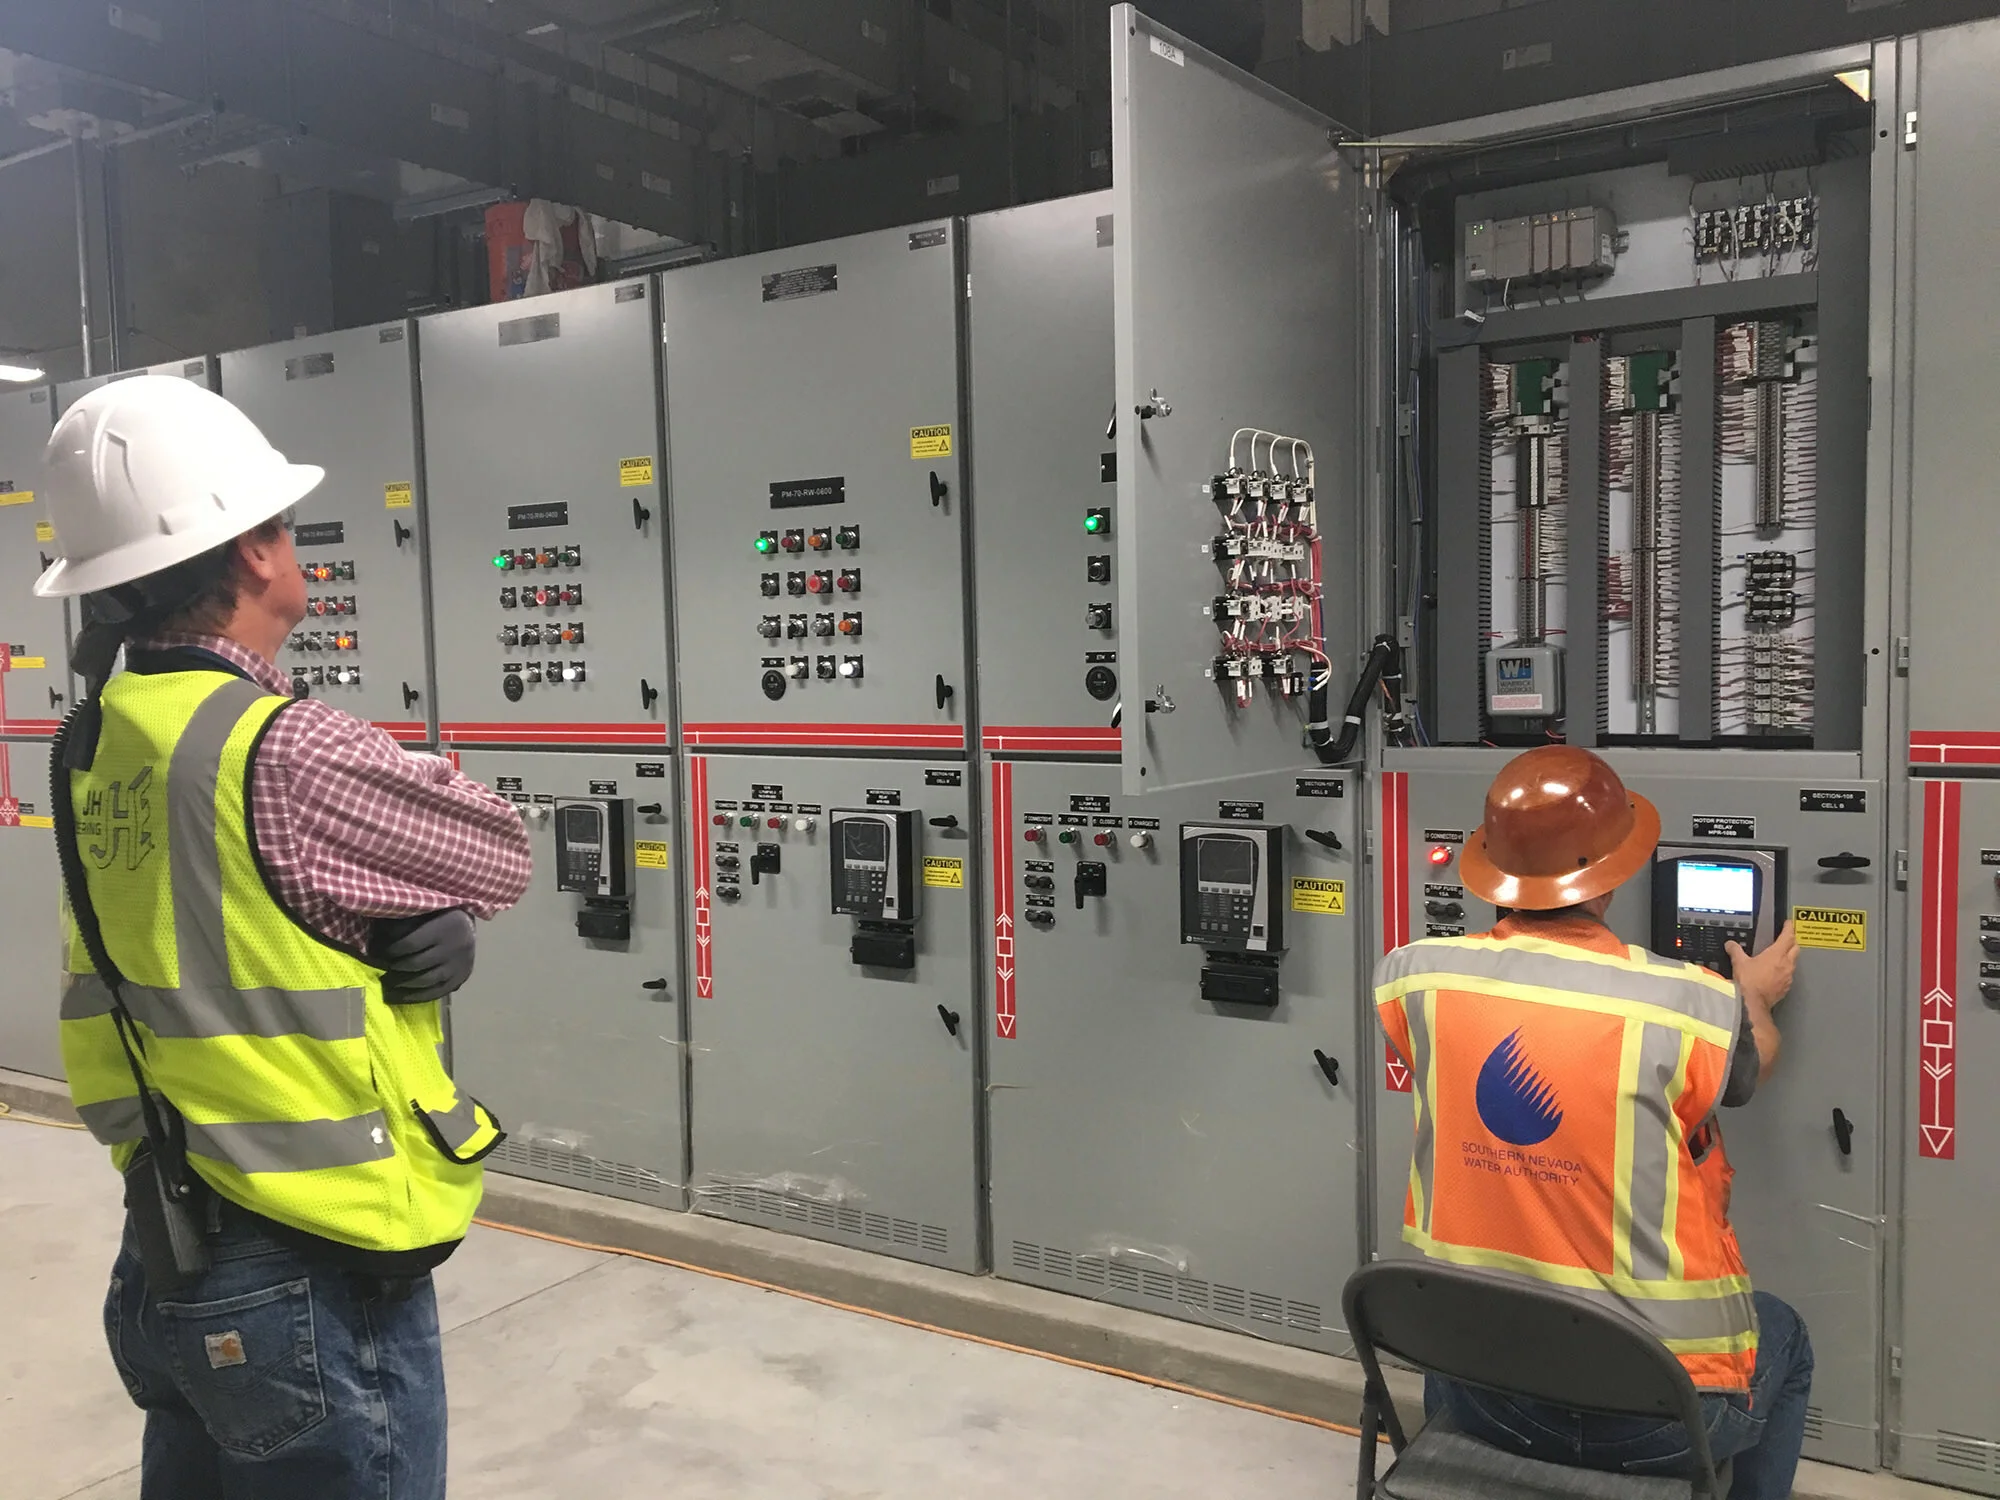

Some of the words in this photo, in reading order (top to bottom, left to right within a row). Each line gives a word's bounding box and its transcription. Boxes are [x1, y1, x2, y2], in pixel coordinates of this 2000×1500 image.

[912, 427, 949, 438] CAUTION
[621, 459, 650, 469] CAUTION
[82, 790, 102, 816] JH
[1430, 832, 1459, 840] CONNECTED
[637, 842, 666, 851] CAUTION
[925, 859, 960, 868] CAUTION
[1296, 880, 1341, 892] CAUTION
[1798, 910, 1861, 923] CAUTION
[1462, 1141, 1525, 1163] SOUTHERN
[1528, 1155, 1583, 1173] NEVADA
[1463, 1156, 1501, 1173] WATER
[1504, 1165, 1580, 1186] AUTHORITY
